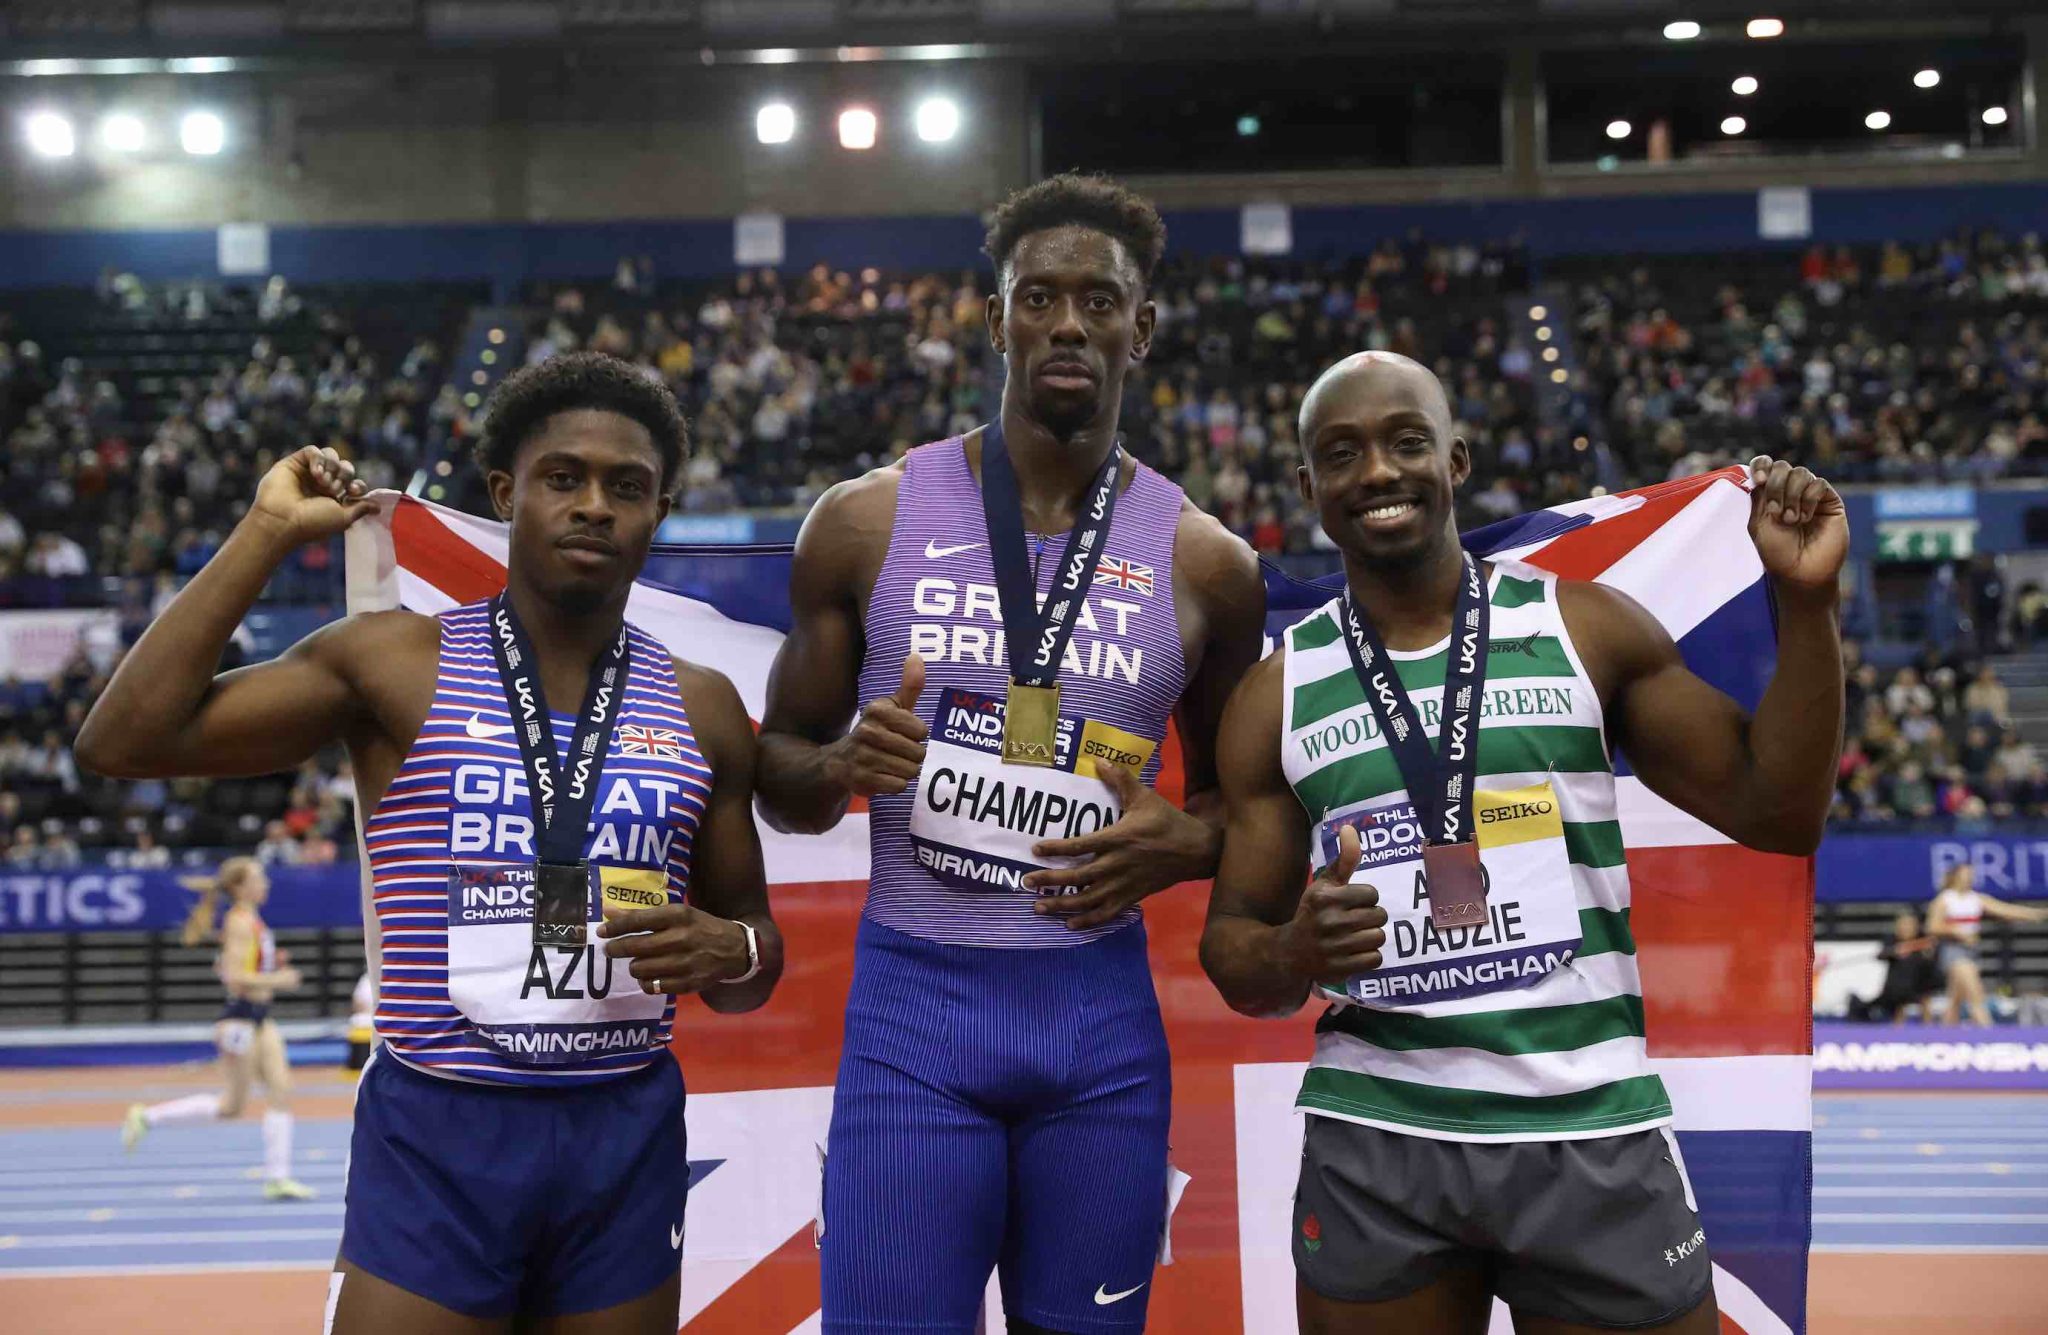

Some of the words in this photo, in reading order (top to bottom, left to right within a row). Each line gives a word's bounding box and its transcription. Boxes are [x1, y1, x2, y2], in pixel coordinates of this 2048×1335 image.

[914, 578, 1141, 635] GRAT
[613, 626, 626, 659] UK
[910, 624, 1142, 685] BRIAIN
[944, 728, 1067, 766] CHAMPIS
[947, 707, 1071, 753] INDR
[1301, 697, 1444, 762] WOODR
[1084, 740, 1142, 766] SEIKO
[454, 764, 679, 818] GRAT
[1480, 801, 1552, 824] SEIKO
[451, 812, 674, 865] BRAIN
[606, 886, 663, 906] SEIKO
[1394, 901, 1526, 959] DADZIE
[520, 944, 612, 1000] AZU
[478, 1027, 649, 1052] RMINGHAM
[1676, 1228, 1706, 1260] KUKR
